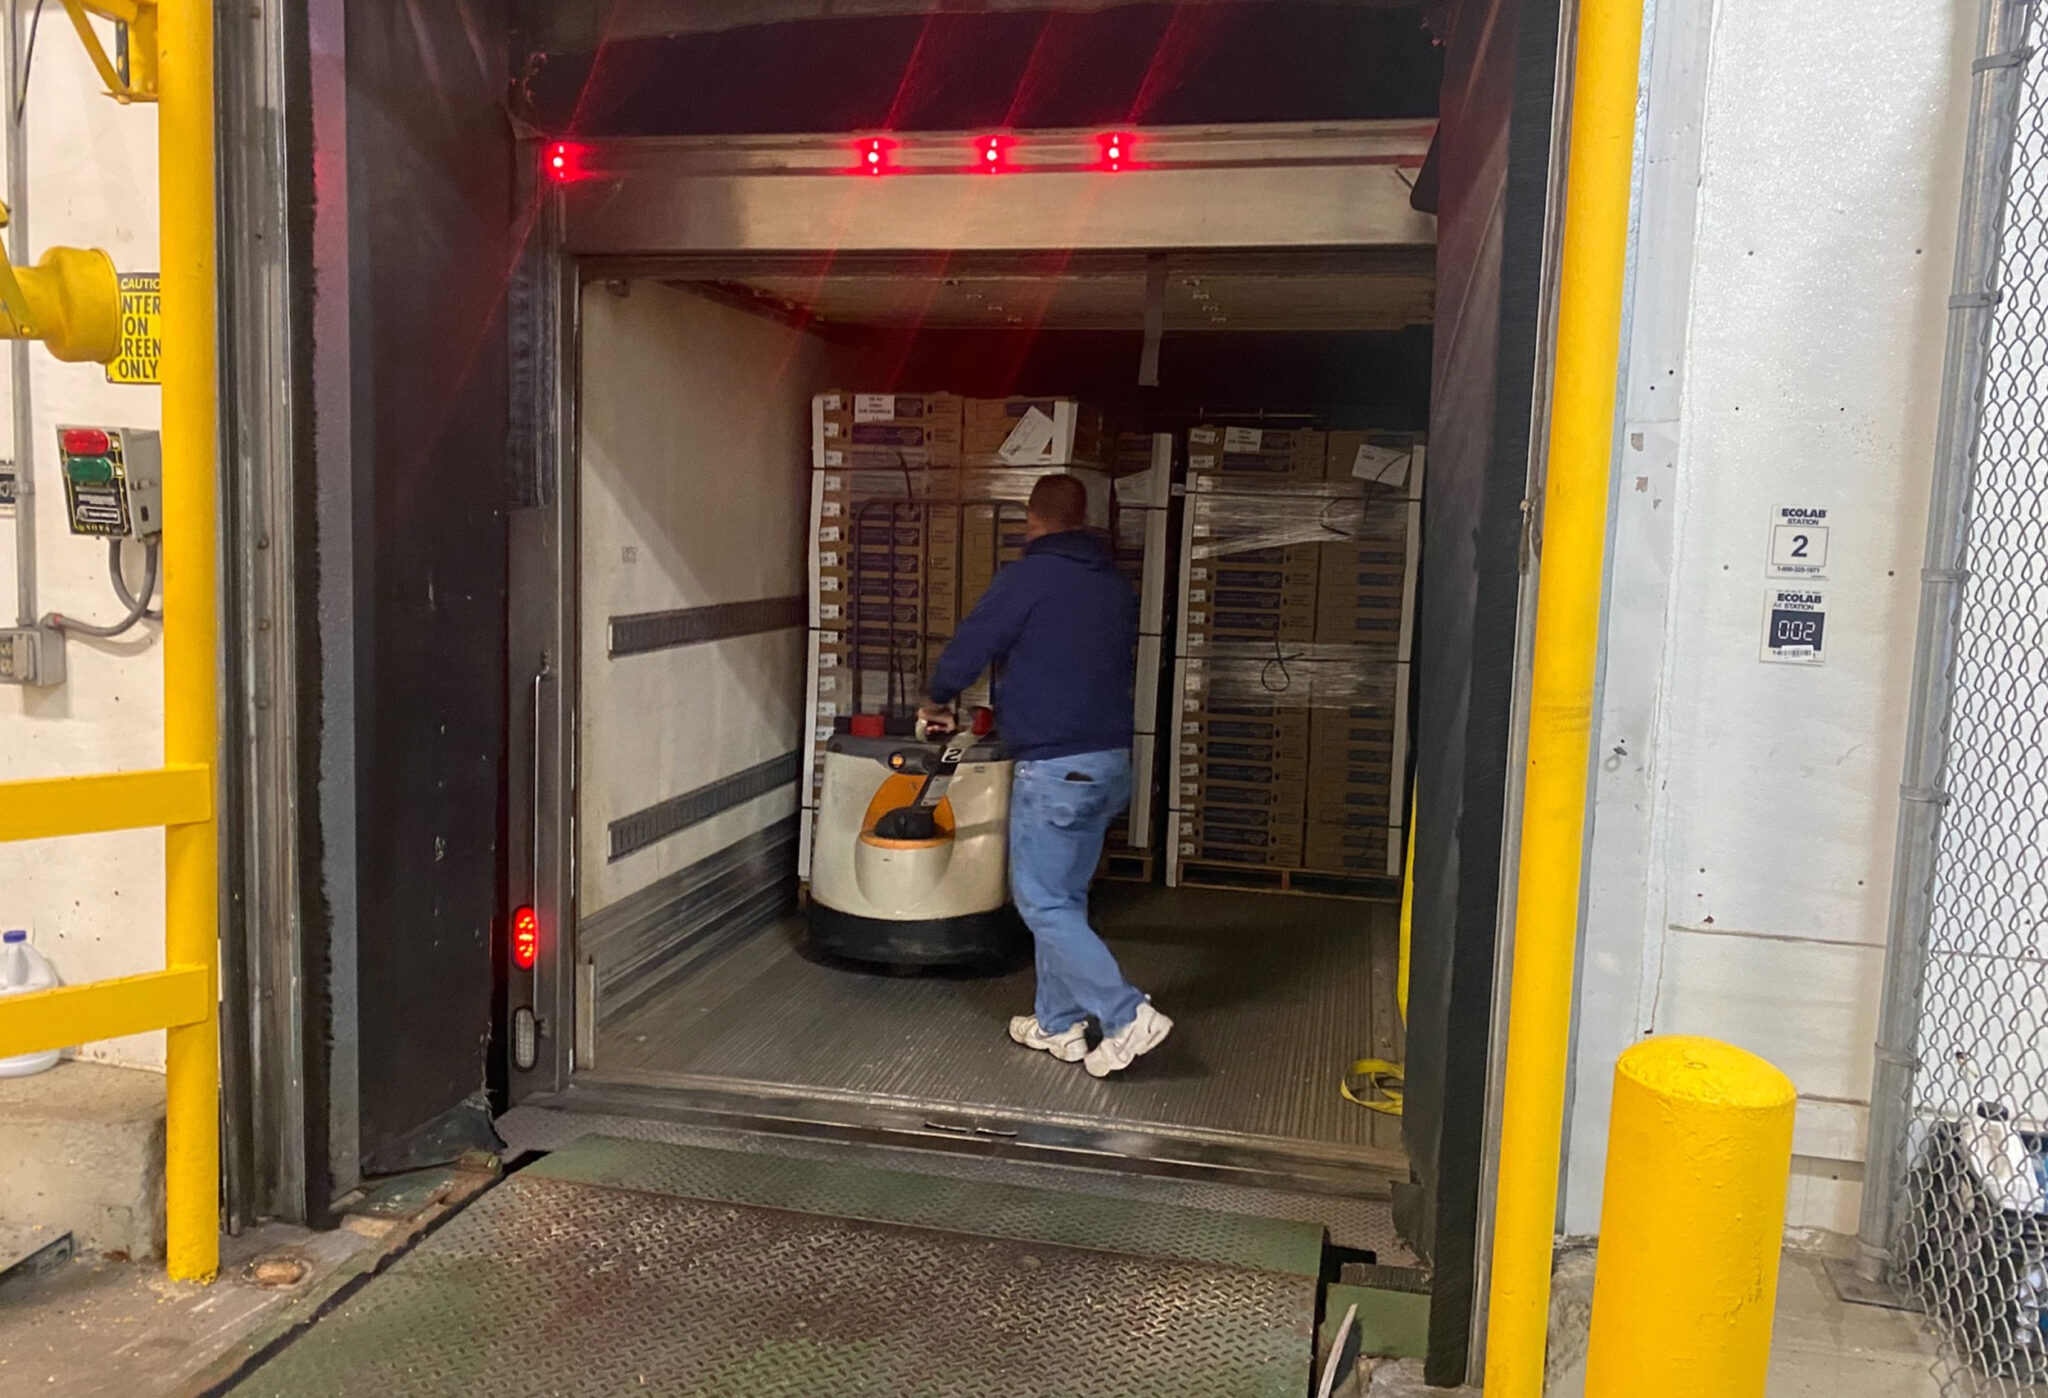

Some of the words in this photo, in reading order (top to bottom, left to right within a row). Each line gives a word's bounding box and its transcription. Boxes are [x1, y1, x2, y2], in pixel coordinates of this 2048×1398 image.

[121, 278, 160, 290] CAUTIO
[122, 295, 160, 314] NTER
[125, 316, 148, 336] ON
[124, 337, 161, 357] REEN
[118, 359, 157, 379] ONLY
[1782, 508, 1826, 518] ECOLAB
[1791, 535, 1808, 557] 2
[1777, 593, 1821, 603] ECOLAB
[1778, 620, 1815, 641] 002
[945, 748, 962, 761] 2
